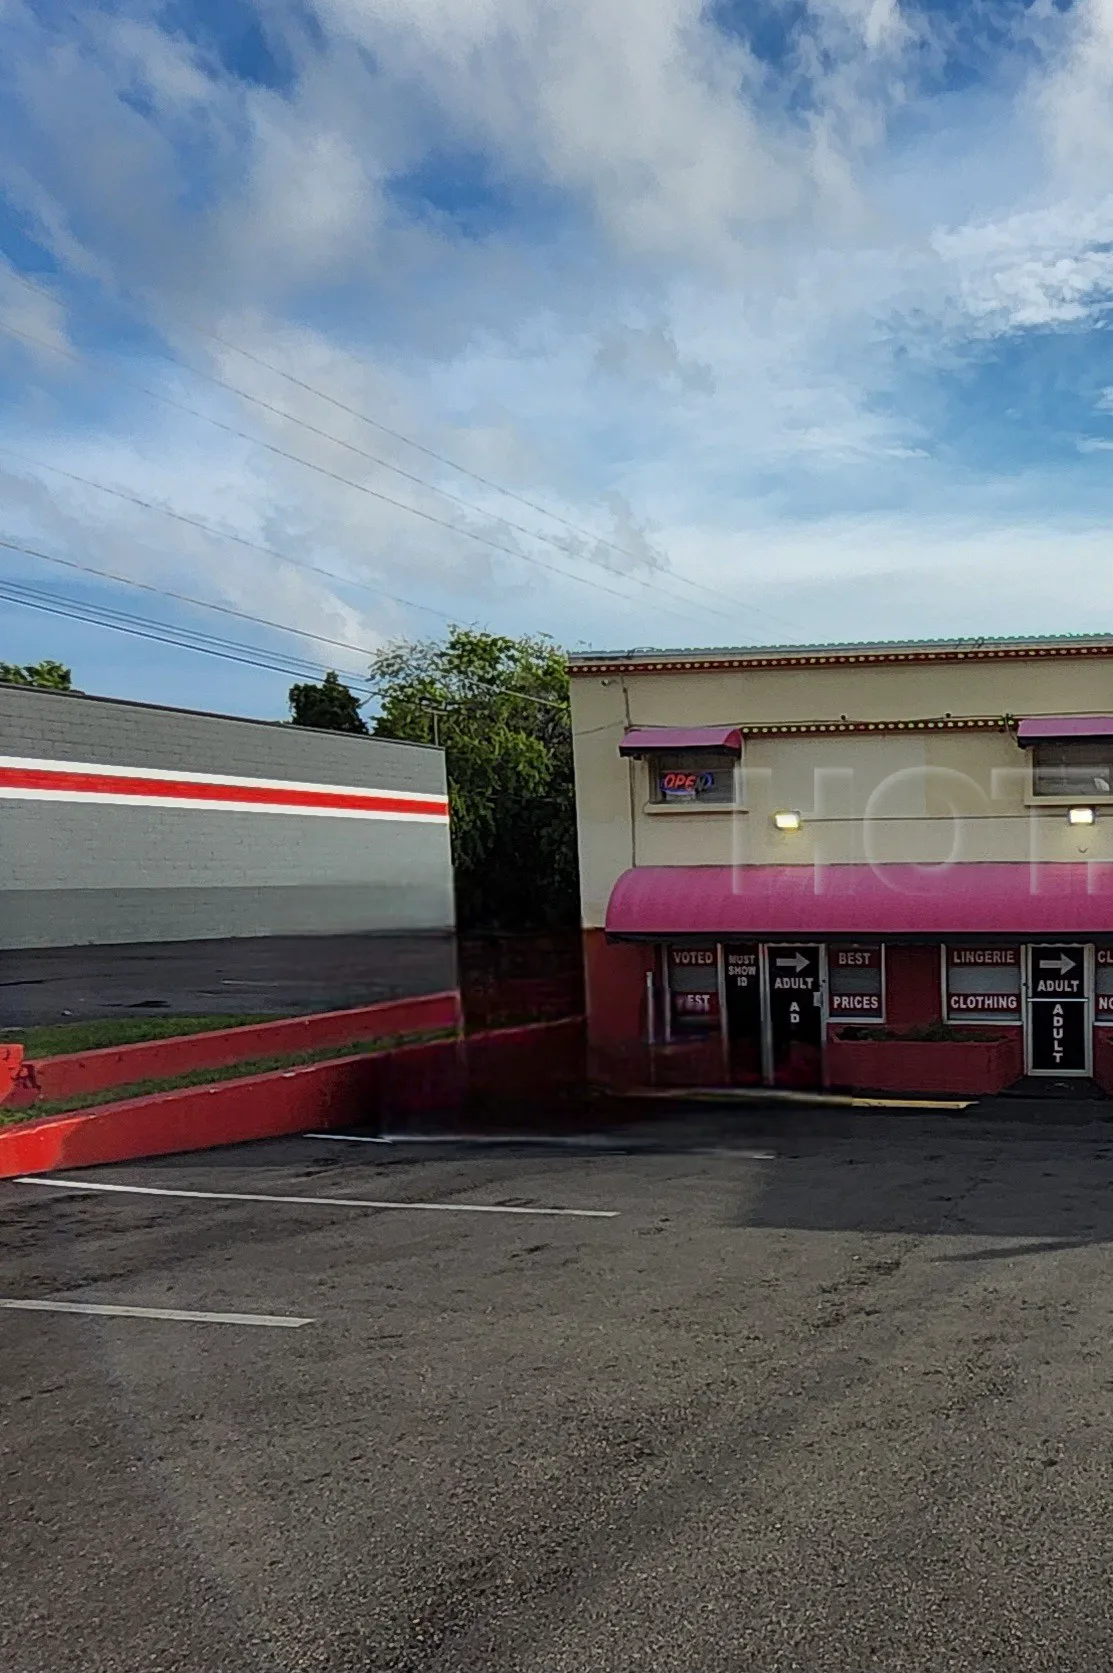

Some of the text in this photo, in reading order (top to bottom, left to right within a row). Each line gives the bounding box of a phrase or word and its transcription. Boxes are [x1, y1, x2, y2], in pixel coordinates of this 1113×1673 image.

[673, 951, 714, 964] VOTED
[728, 955, 756, 964] MUST
[838, 952, 872, 965] BEST
[953, 951, 1016, 964] LINGERIE
[728, 966, 757, 976] SHOW
[737, 976, 748, 987] ID
[774, 977, 814, 989] ADULT
[1037, 980, 1079, 992] ADULT
[833, 996, 879, 1009] PRICES
[950, 996, 1017, 1009] CLOTHING
[1052, 1003, 1064, 1064] ADULT
